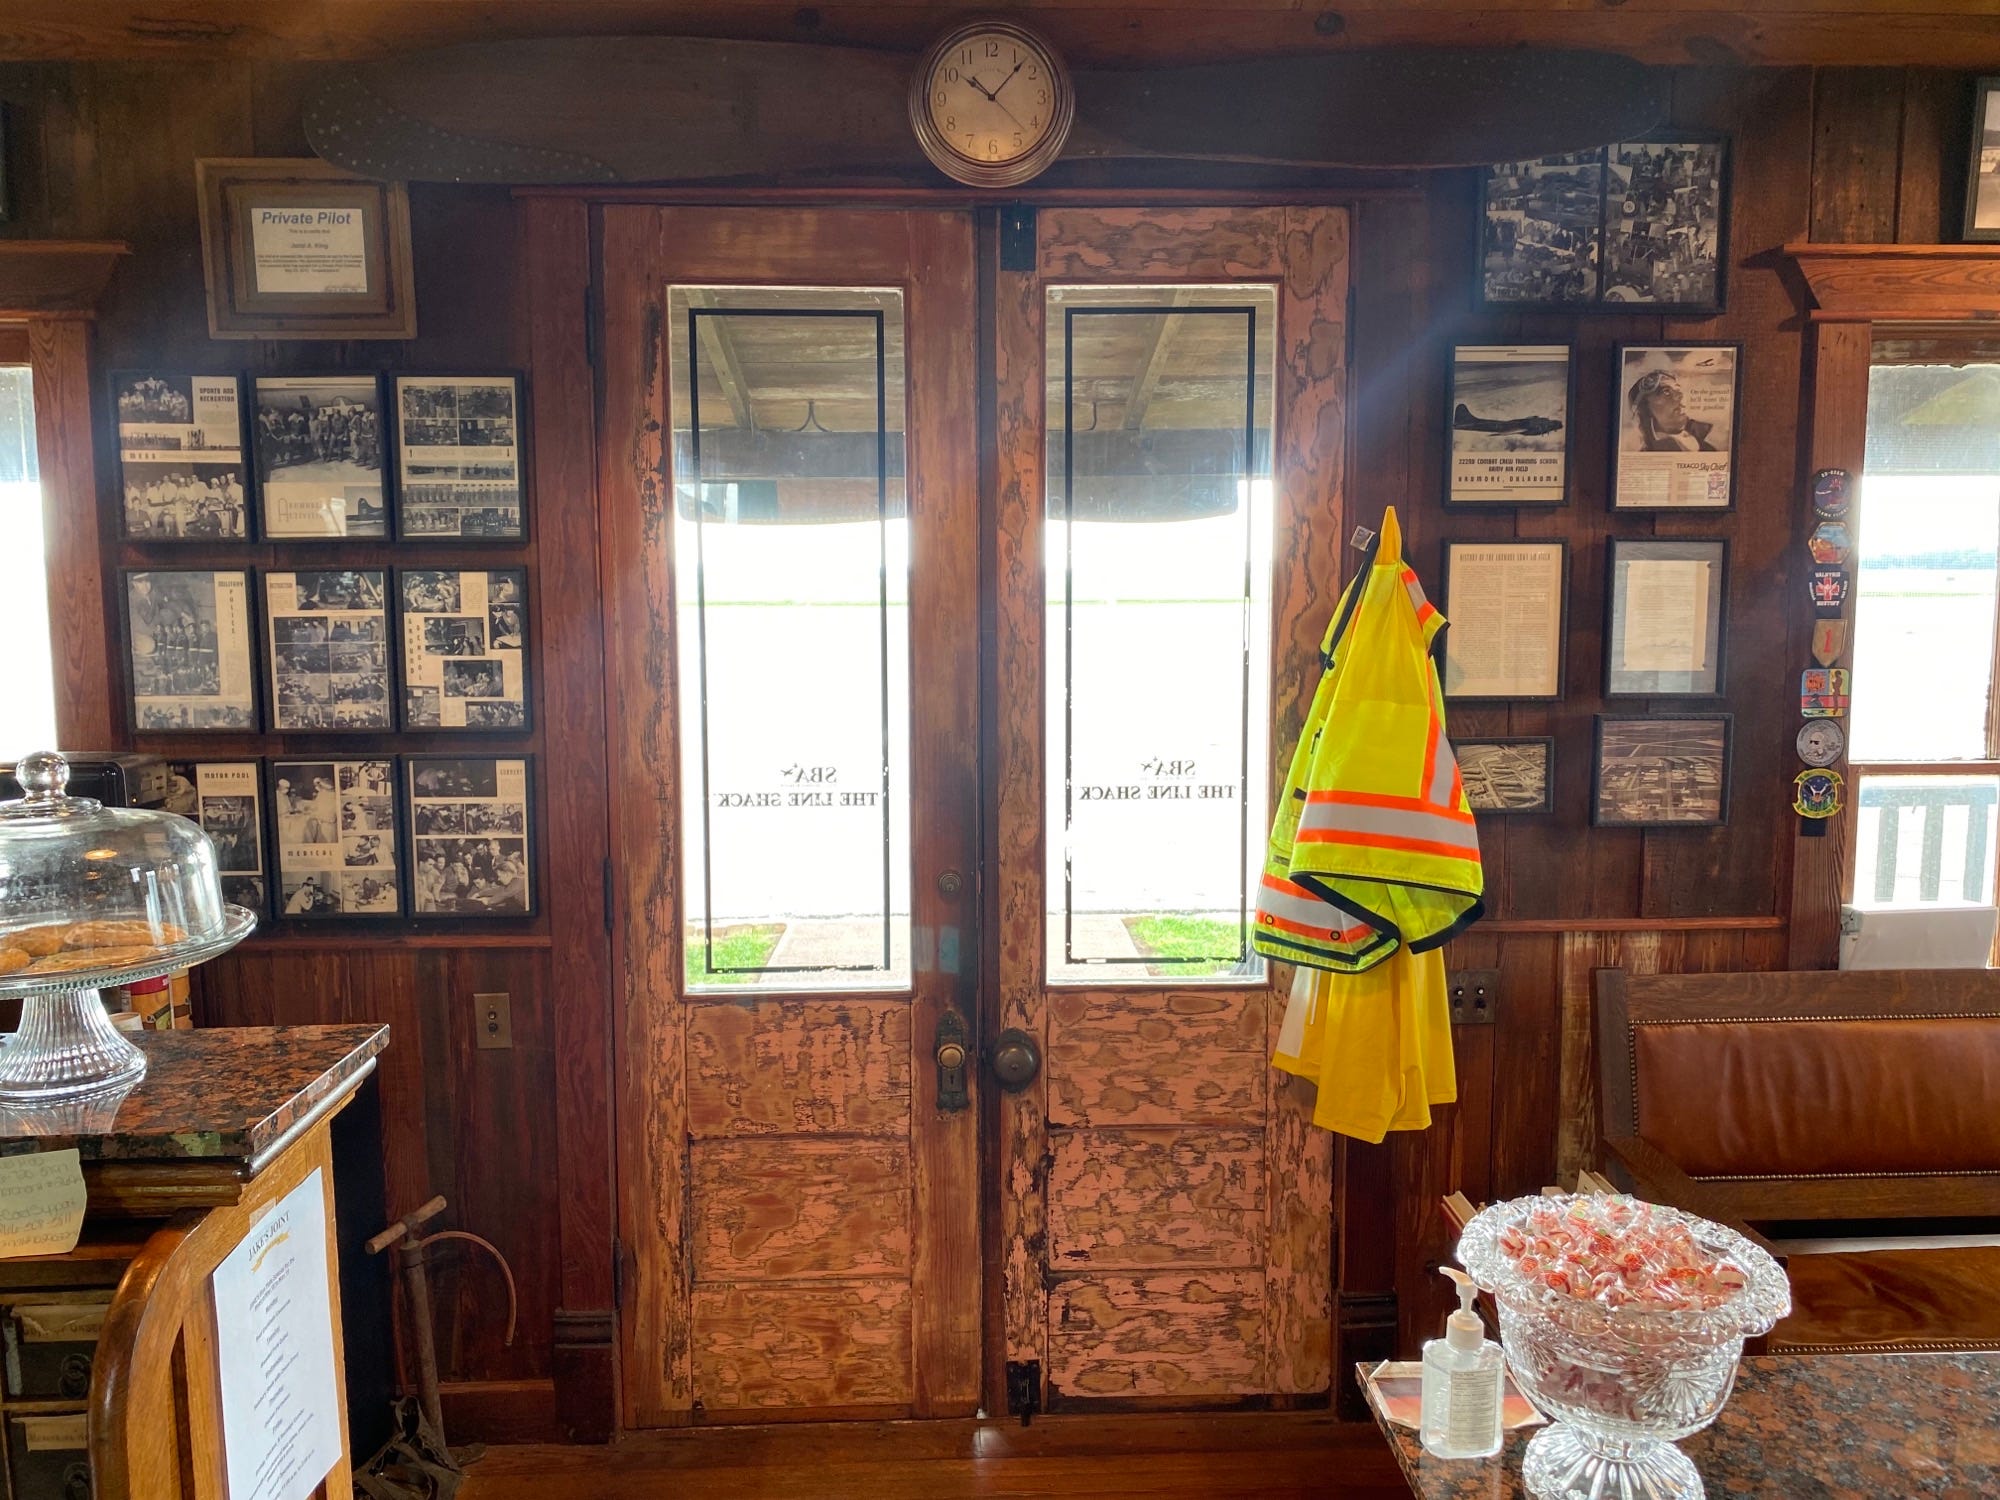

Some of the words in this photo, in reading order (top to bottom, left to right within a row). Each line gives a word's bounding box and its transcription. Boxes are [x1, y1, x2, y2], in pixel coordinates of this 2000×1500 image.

[961, 50, 972, 64] 11
[984, 42, 998, 57] 12
[1012, 48, 1017, 63] 1
[944, 67, 958, 83] 10
[1028, 65, 1037, 80] 2
[937, 92, 947, 107] 9
[1037, 89, 1046, 105] 3
[946, 116, 956, 131] 8
[1030, 115, 1039, 129] 4
[965, 134, 974, 148] 7
[989, 139, 997, 154] 6
[1013, 133, 1022, 147] 5
[262, 211, 313, 225] Private
[317, 211, 351, 225] Pilot
[1710, 462, 1728, 471] Chief
[248, 1230, 269, 1261] JAKE'S
[270, 1209, 290, 1238] JOINT
